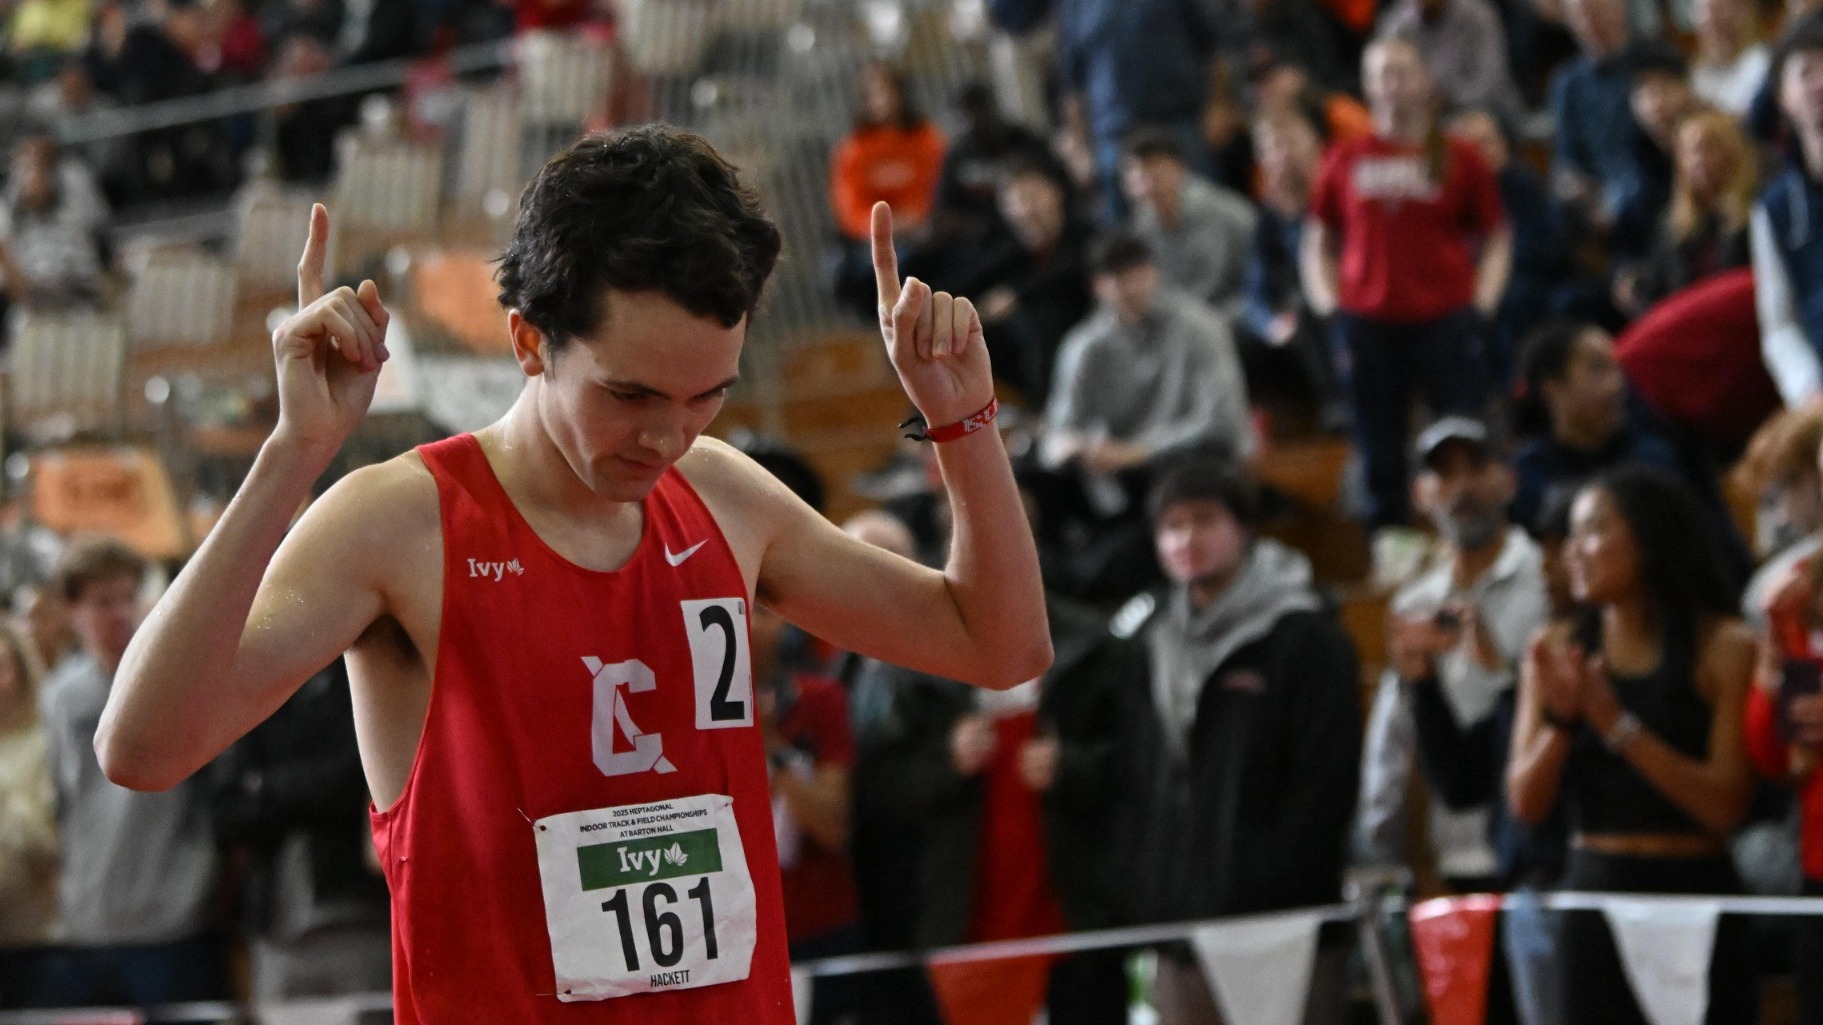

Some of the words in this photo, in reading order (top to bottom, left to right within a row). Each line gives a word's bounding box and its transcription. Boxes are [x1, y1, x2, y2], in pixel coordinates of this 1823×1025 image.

[467, 558, 504, 582] Ivy
[699, 605, 745, 721] 2
[579, 822, 608, 833] INDOOR
[608, 819, 630, 829] TRACK
[631, 818, 636, 826] &
[637, 815, 656, 825] FIELD
[656, 808, 708, 822] CHAMPIONSHIPS
[612, 809, 629, 818] 2025
[629, 803, 674, 815] HEPTAGONAL
[620, 830, 629, 838] AT
[629, 827, 656, 837] BARTON
[657, 824, 674, 833] HALL
[616, 846, 661, 876] Ivy
[601, 876, 718, 972] 161
[650, 969, 690, 988] HACKETT
